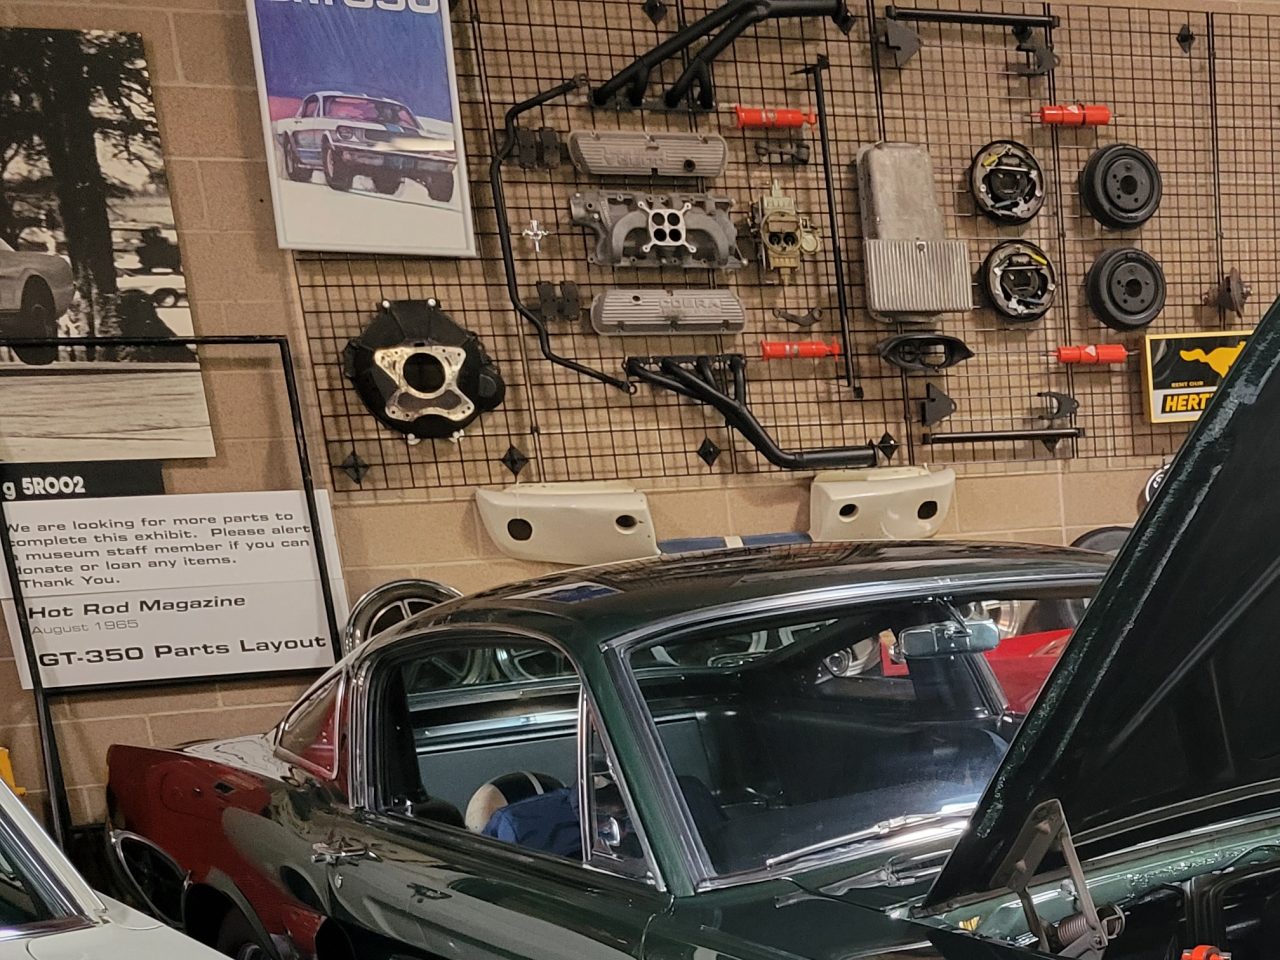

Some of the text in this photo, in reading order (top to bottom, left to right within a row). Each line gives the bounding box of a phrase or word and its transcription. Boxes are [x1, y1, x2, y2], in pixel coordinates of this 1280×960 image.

[1164, 392, 1215, 412] HERT
[37, 523, 66, 532] are
[73, 520, 135, 532] looking
[141, 517, 167, 527] for
[173, 516, 217, 525] more
[223, 513, 269, 525] parts
[275, 512, 294, 521] to
[94, 533, 128, 543] this
[134, 528, 198, 542] exhibit.
[211, 527, 266, 538] Please
[271, 525, 311, 534] alert
[26, 549, 100, 561] museum
[106, 545, 148, 556] staff
[154, 541, 223, 554] member
[229, 540, 240, 550] if
[246, 540, 275, 551] you
[281, 539, 310, 547] can
[106, 560, 142, 570] loan
[148, 559, 177, 571] any
[183, 556, 237, 567] items.
[20, 575, 121, 589] Thank You.
[28, 595, 246, 620] Hot Rod Magazine
[31, 619, 139, 636] August 1965
[38, 635, 327, 668] GT-350 Parts Layout
